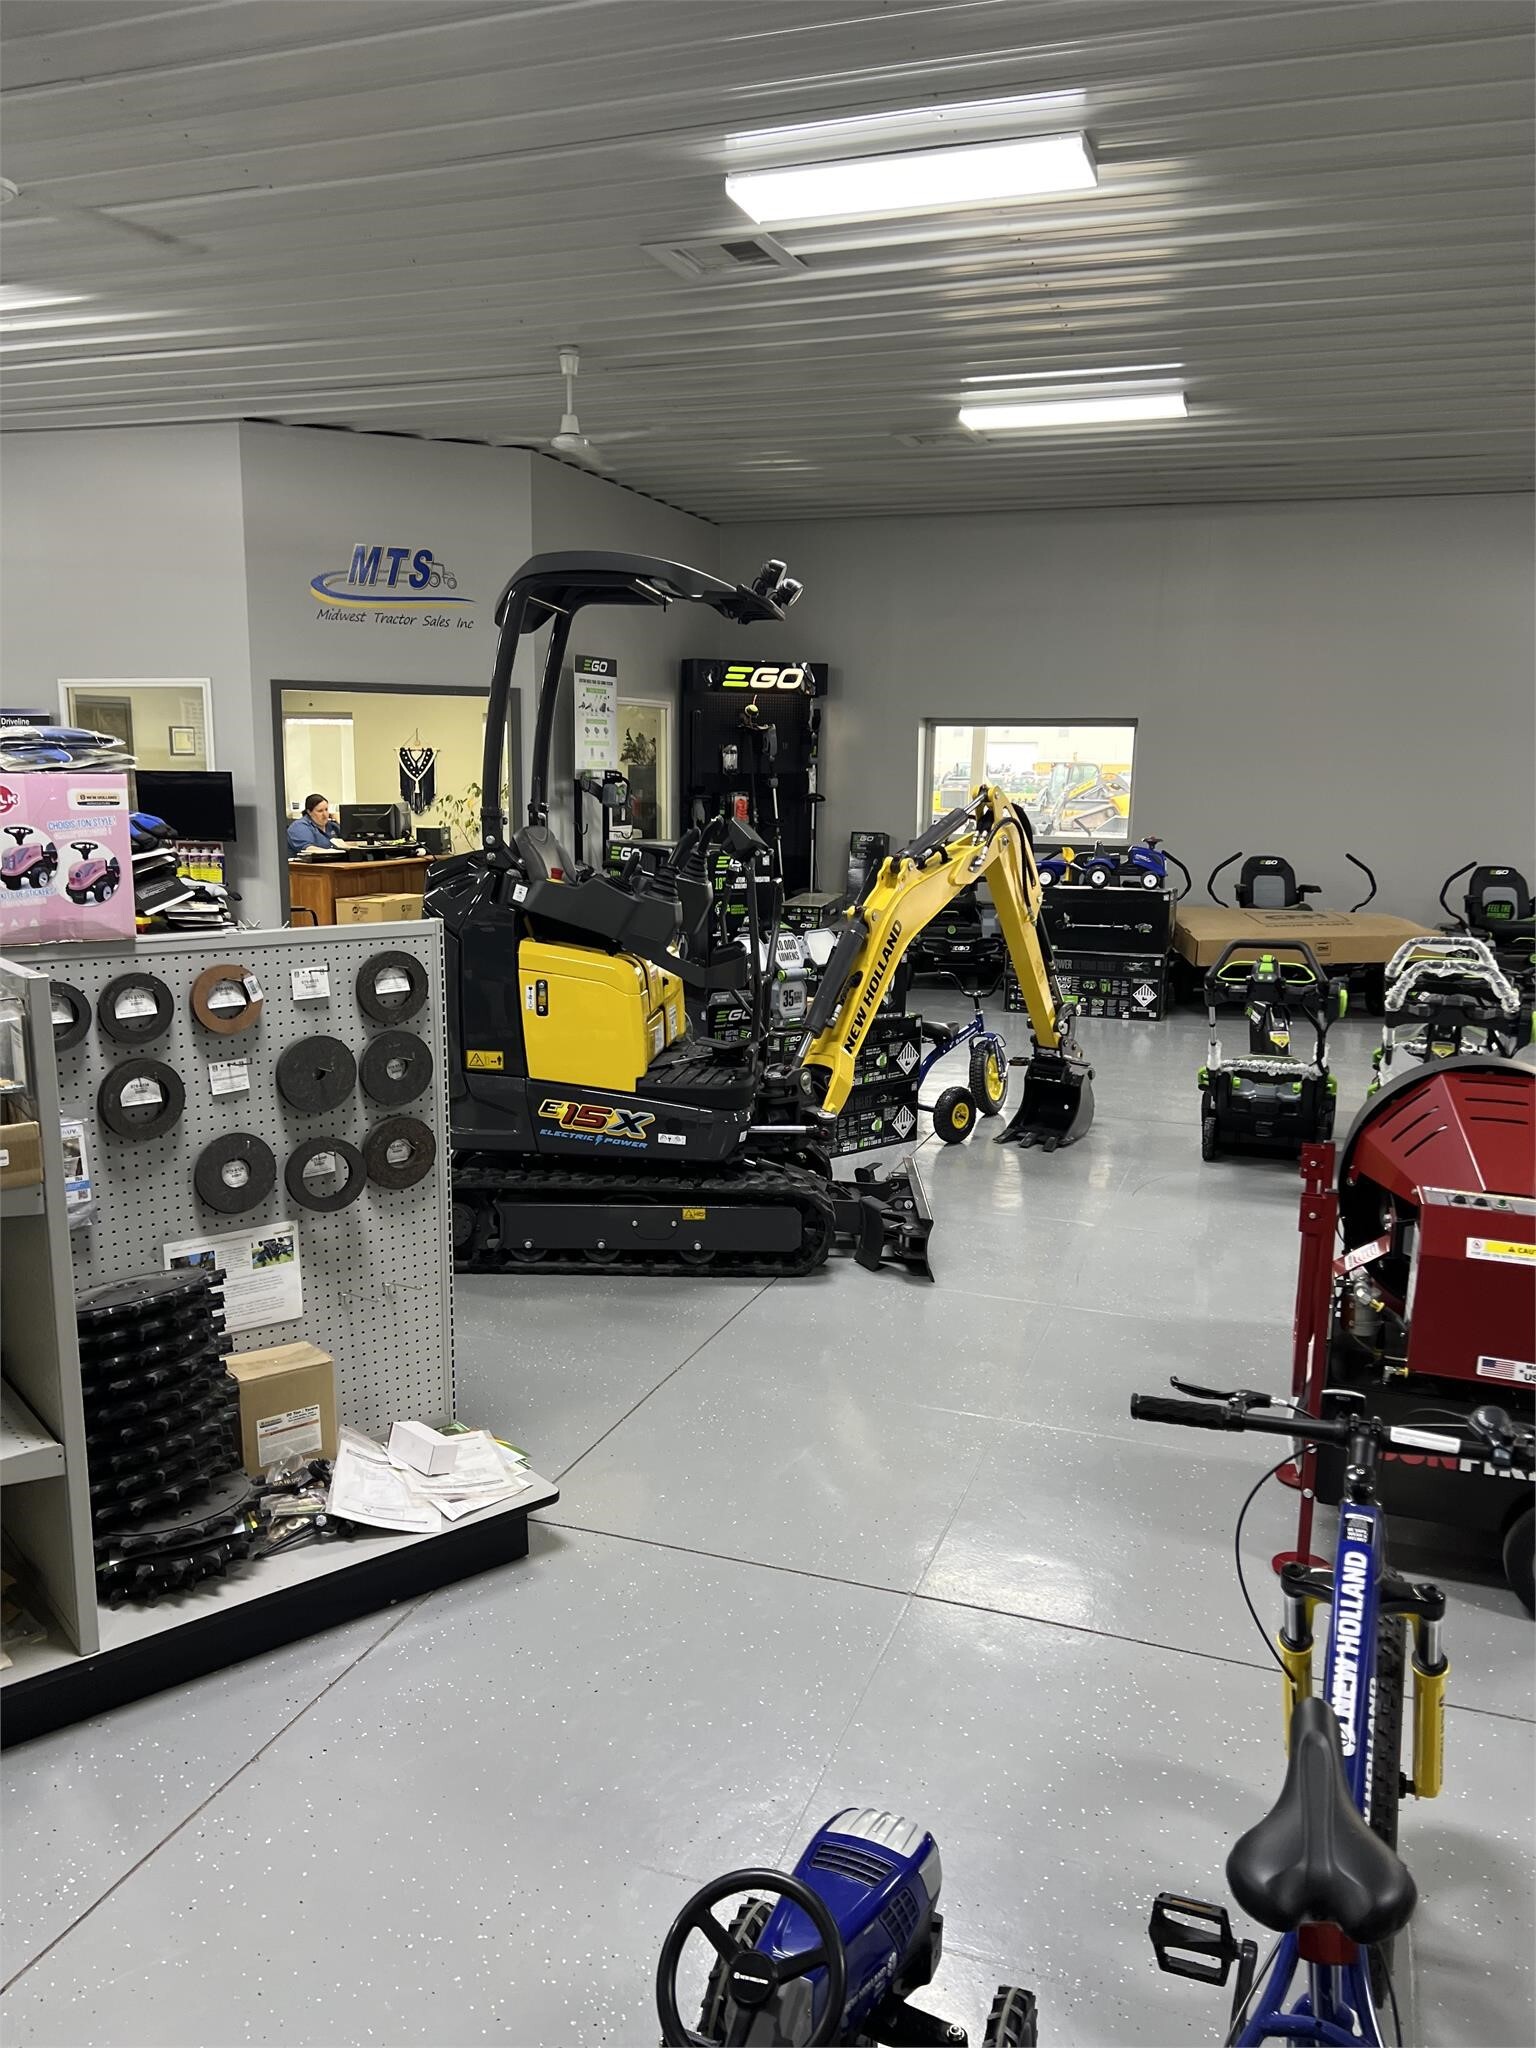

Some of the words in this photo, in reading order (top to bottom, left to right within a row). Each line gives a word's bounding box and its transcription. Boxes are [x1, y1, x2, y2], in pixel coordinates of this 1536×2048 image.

[347, 543, 433, 590] MTS
[316, 608, 367, 623] Midwest
[374, 612, 417, 625] Tractor
[422, 615, 450, 628] Sales
[456, 617, 474, 629] Inc
[584, 659, 608, 673] EGO
[722, 665, 805, 689] EGO
[1, 717, 30, 726] Driveline
[0, 794, 19, 805] LK
[778, 951, 800, 962] LUMENS
[843, 1007, 867, 1055] NEW
[864, 919, 902, 1007] HOLLAND
[783, 989, 795, 1008] 35
[538, 1098, 655, 1139] E15X
[539, 1129, 595, 1141] ELECTRIC
[603, 1137, 648, 1149] POWER
[1336, 1551, 1368, 1657] HOLLAND
